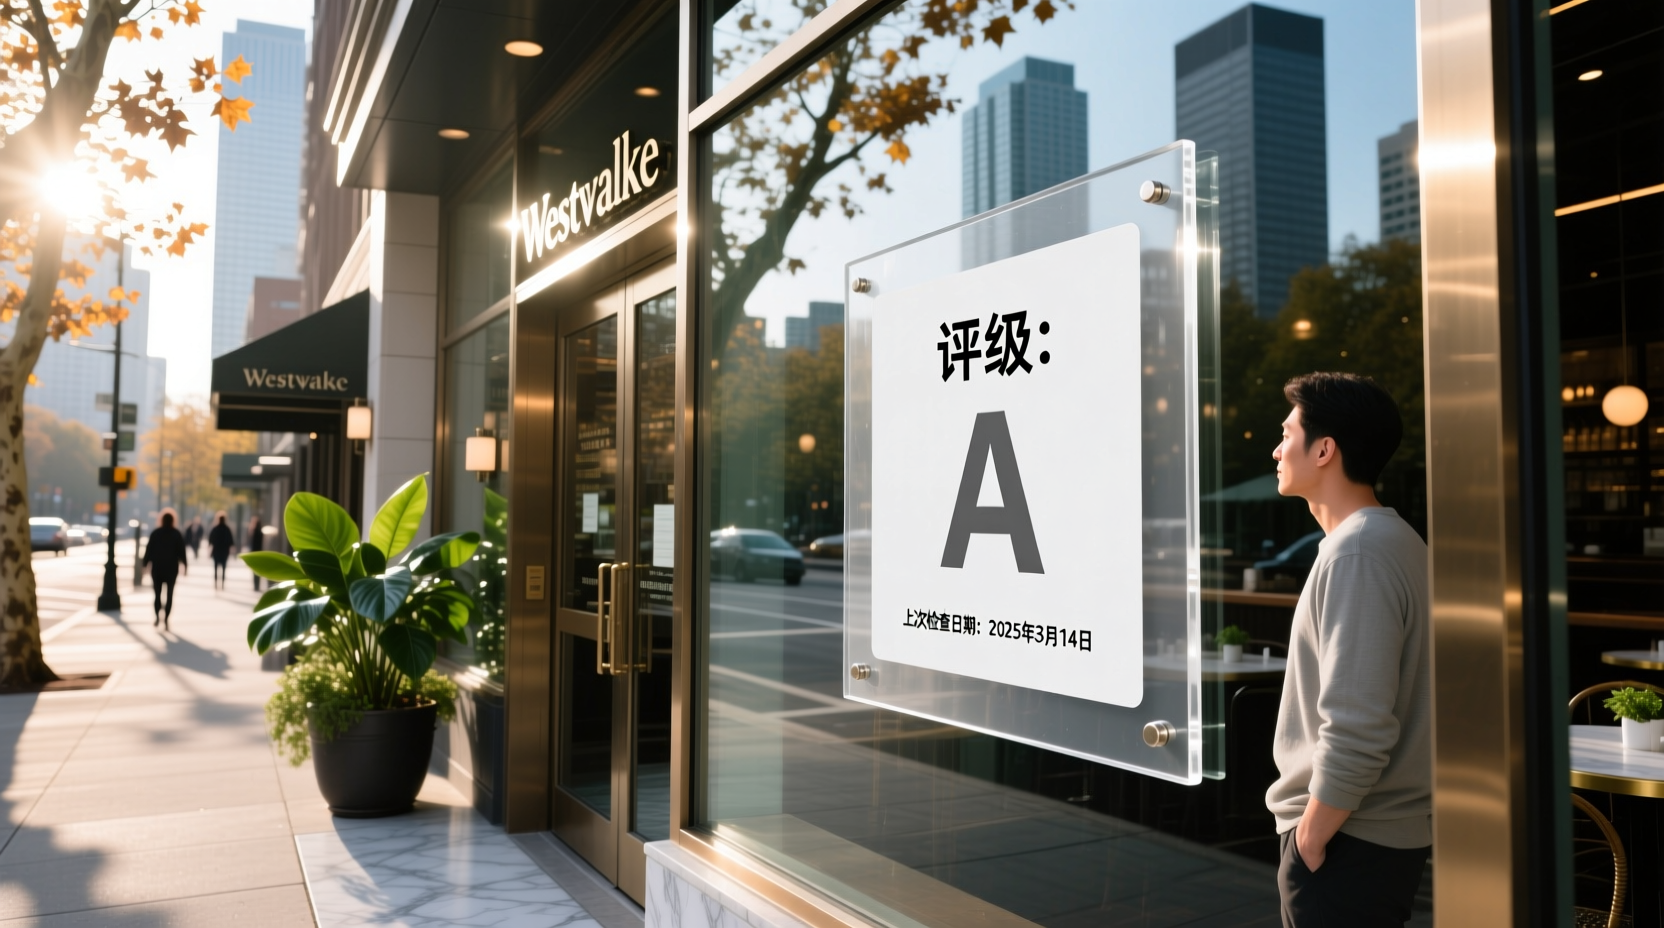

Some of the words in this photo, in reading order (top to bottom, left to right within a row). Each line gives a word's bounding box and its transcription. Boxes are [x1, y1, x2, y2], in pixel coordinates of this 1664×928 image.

[520, 130, 660, 263] Westvalke
[936, 309, 1051, 383] 评级：
[940, 410, 1045, 575] A
